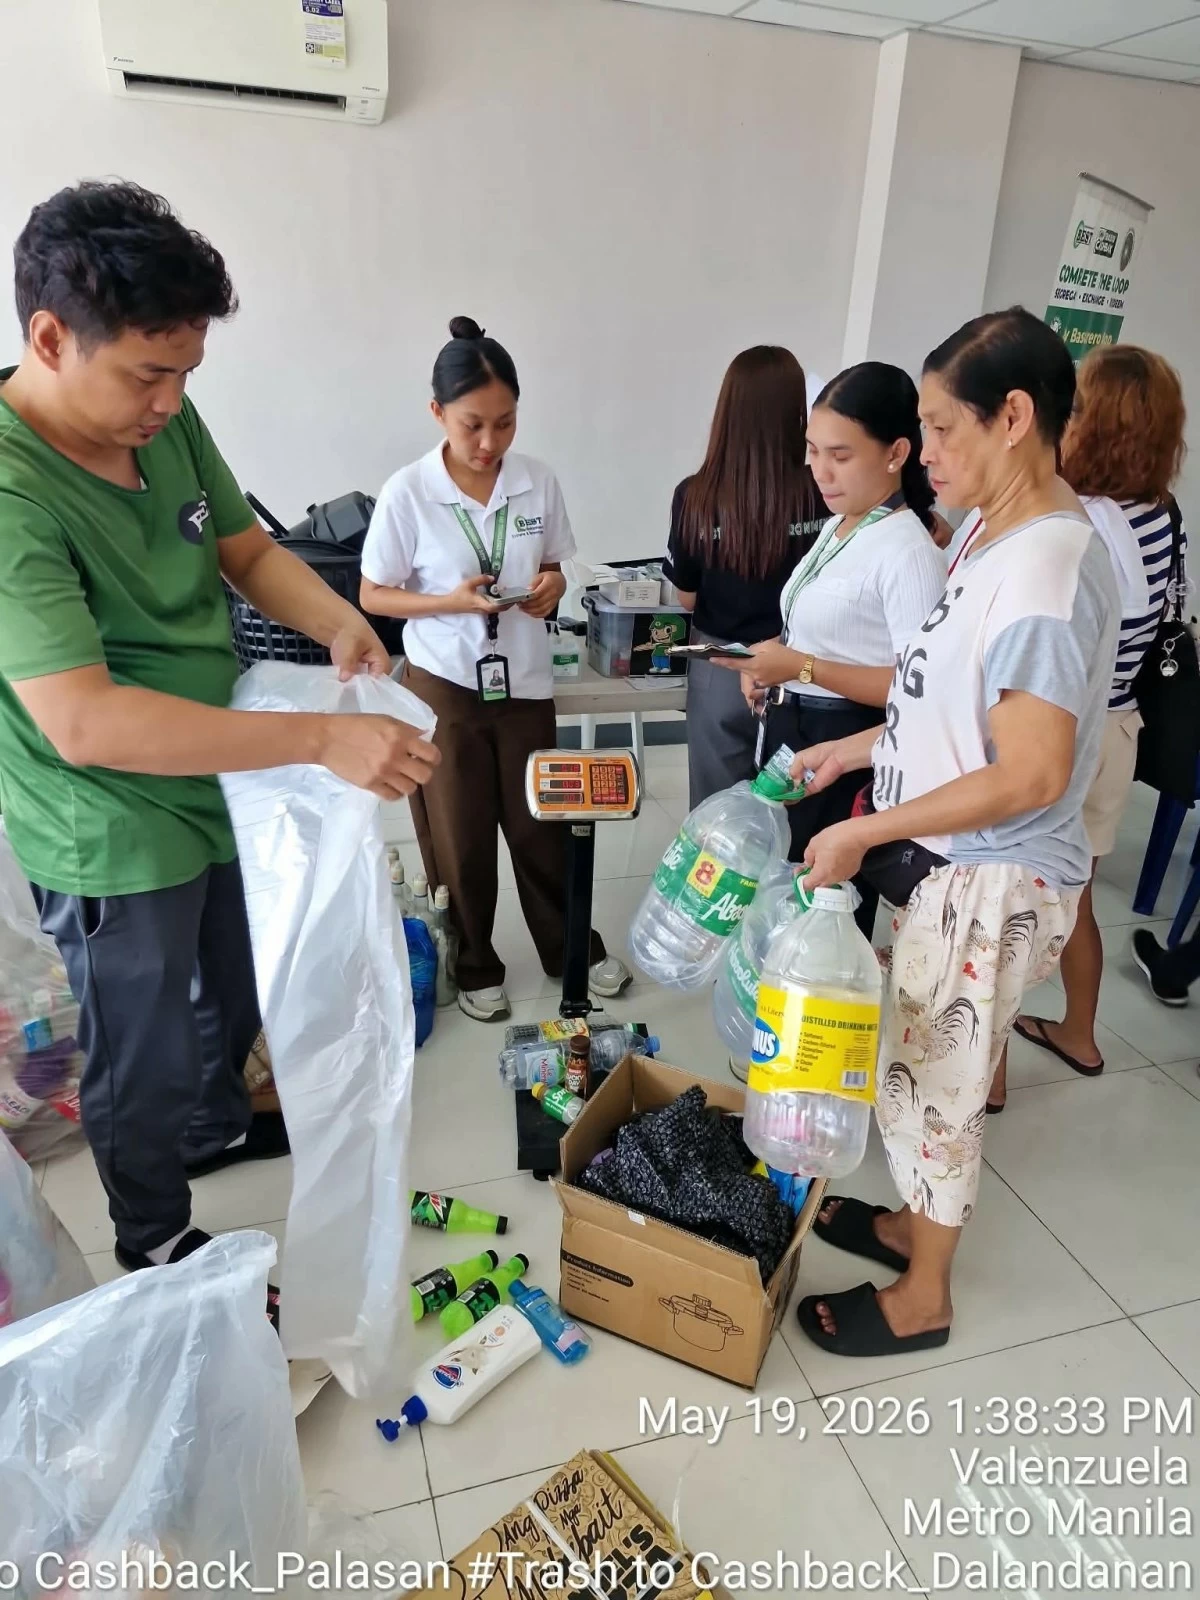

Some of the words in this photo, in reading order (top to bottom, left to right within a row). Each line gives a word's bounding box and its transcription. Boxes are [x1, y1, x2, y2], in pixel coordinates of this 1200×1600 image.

[518, 516, 542, 527] BEST
[696, 861, 716, 885] 8
[802, 1015, 837, 1028] DISTILLED
[593, 1265, 631, 1285] Information
[504, 1514, 538, 1551] Ang
[533, 1469, 584, 1515] Pizza
